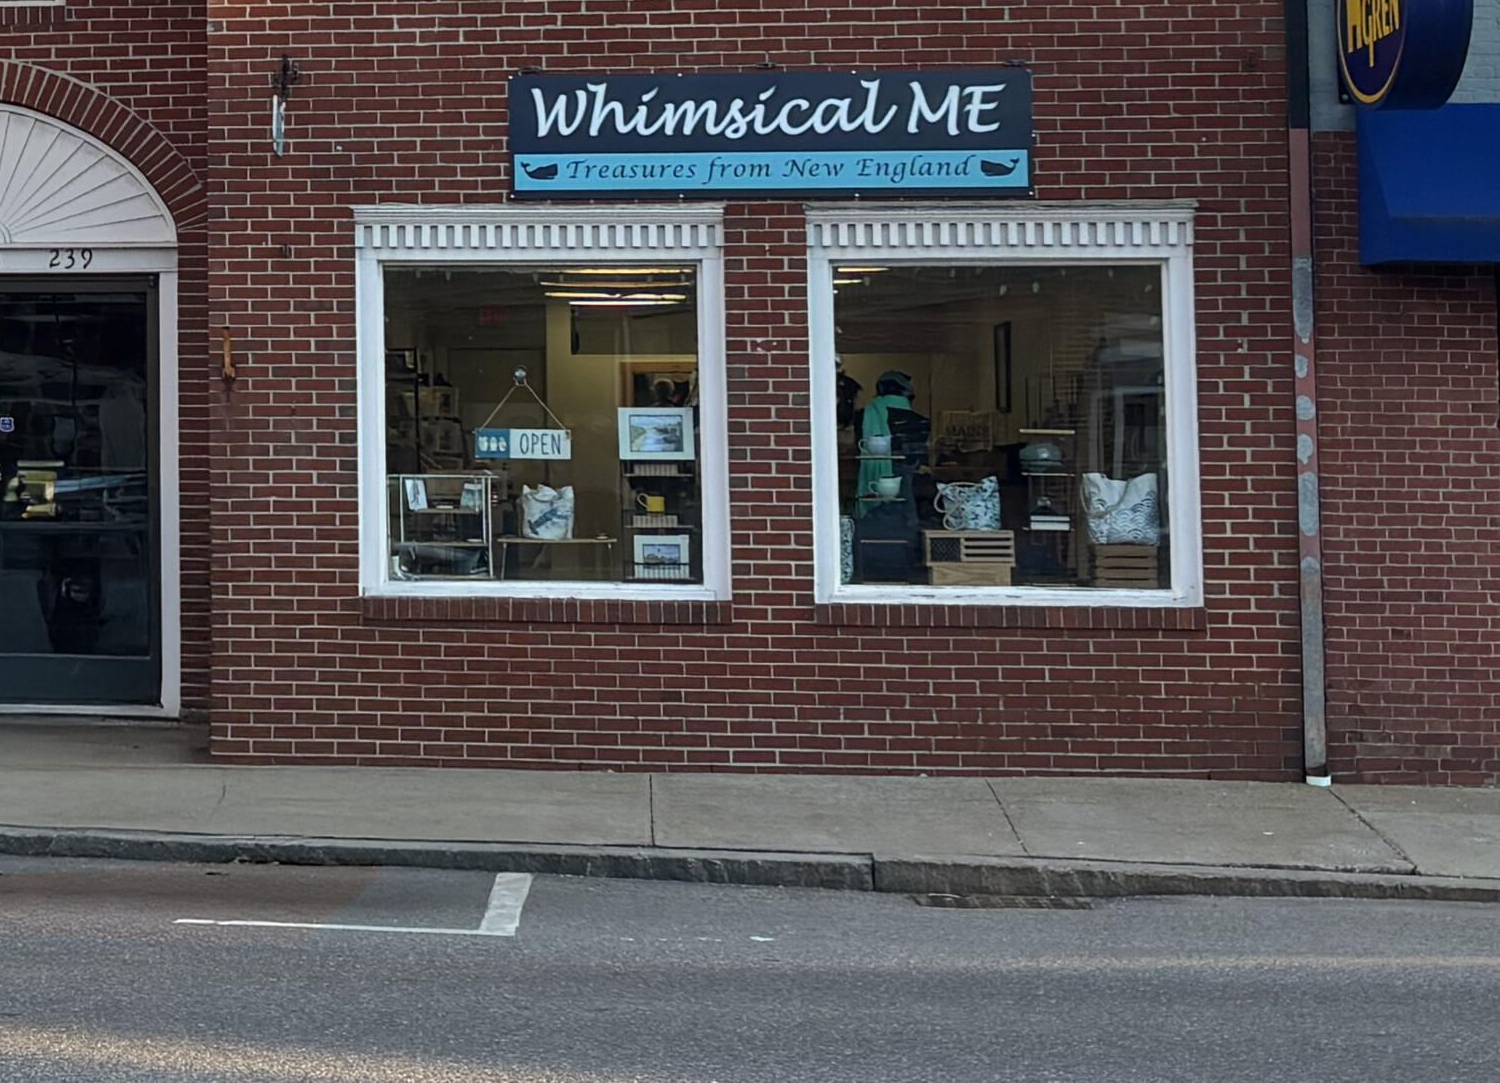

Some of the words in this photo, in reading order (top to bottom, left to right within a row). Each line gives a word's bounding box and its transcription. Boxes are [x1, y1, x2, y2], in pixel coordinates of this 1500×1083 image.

[531, 78, 898, 140] Whimsical
[906, 81, 1007, 135] ME
[565, 158, 697, 180] Treasures
[701, 157, 771, 185] from
[781, 157, 845, 180] New
[854, 154, 972, 184] England
[49, 248, 93, 269] 239
[519, 432, 562, 456] OPEN
